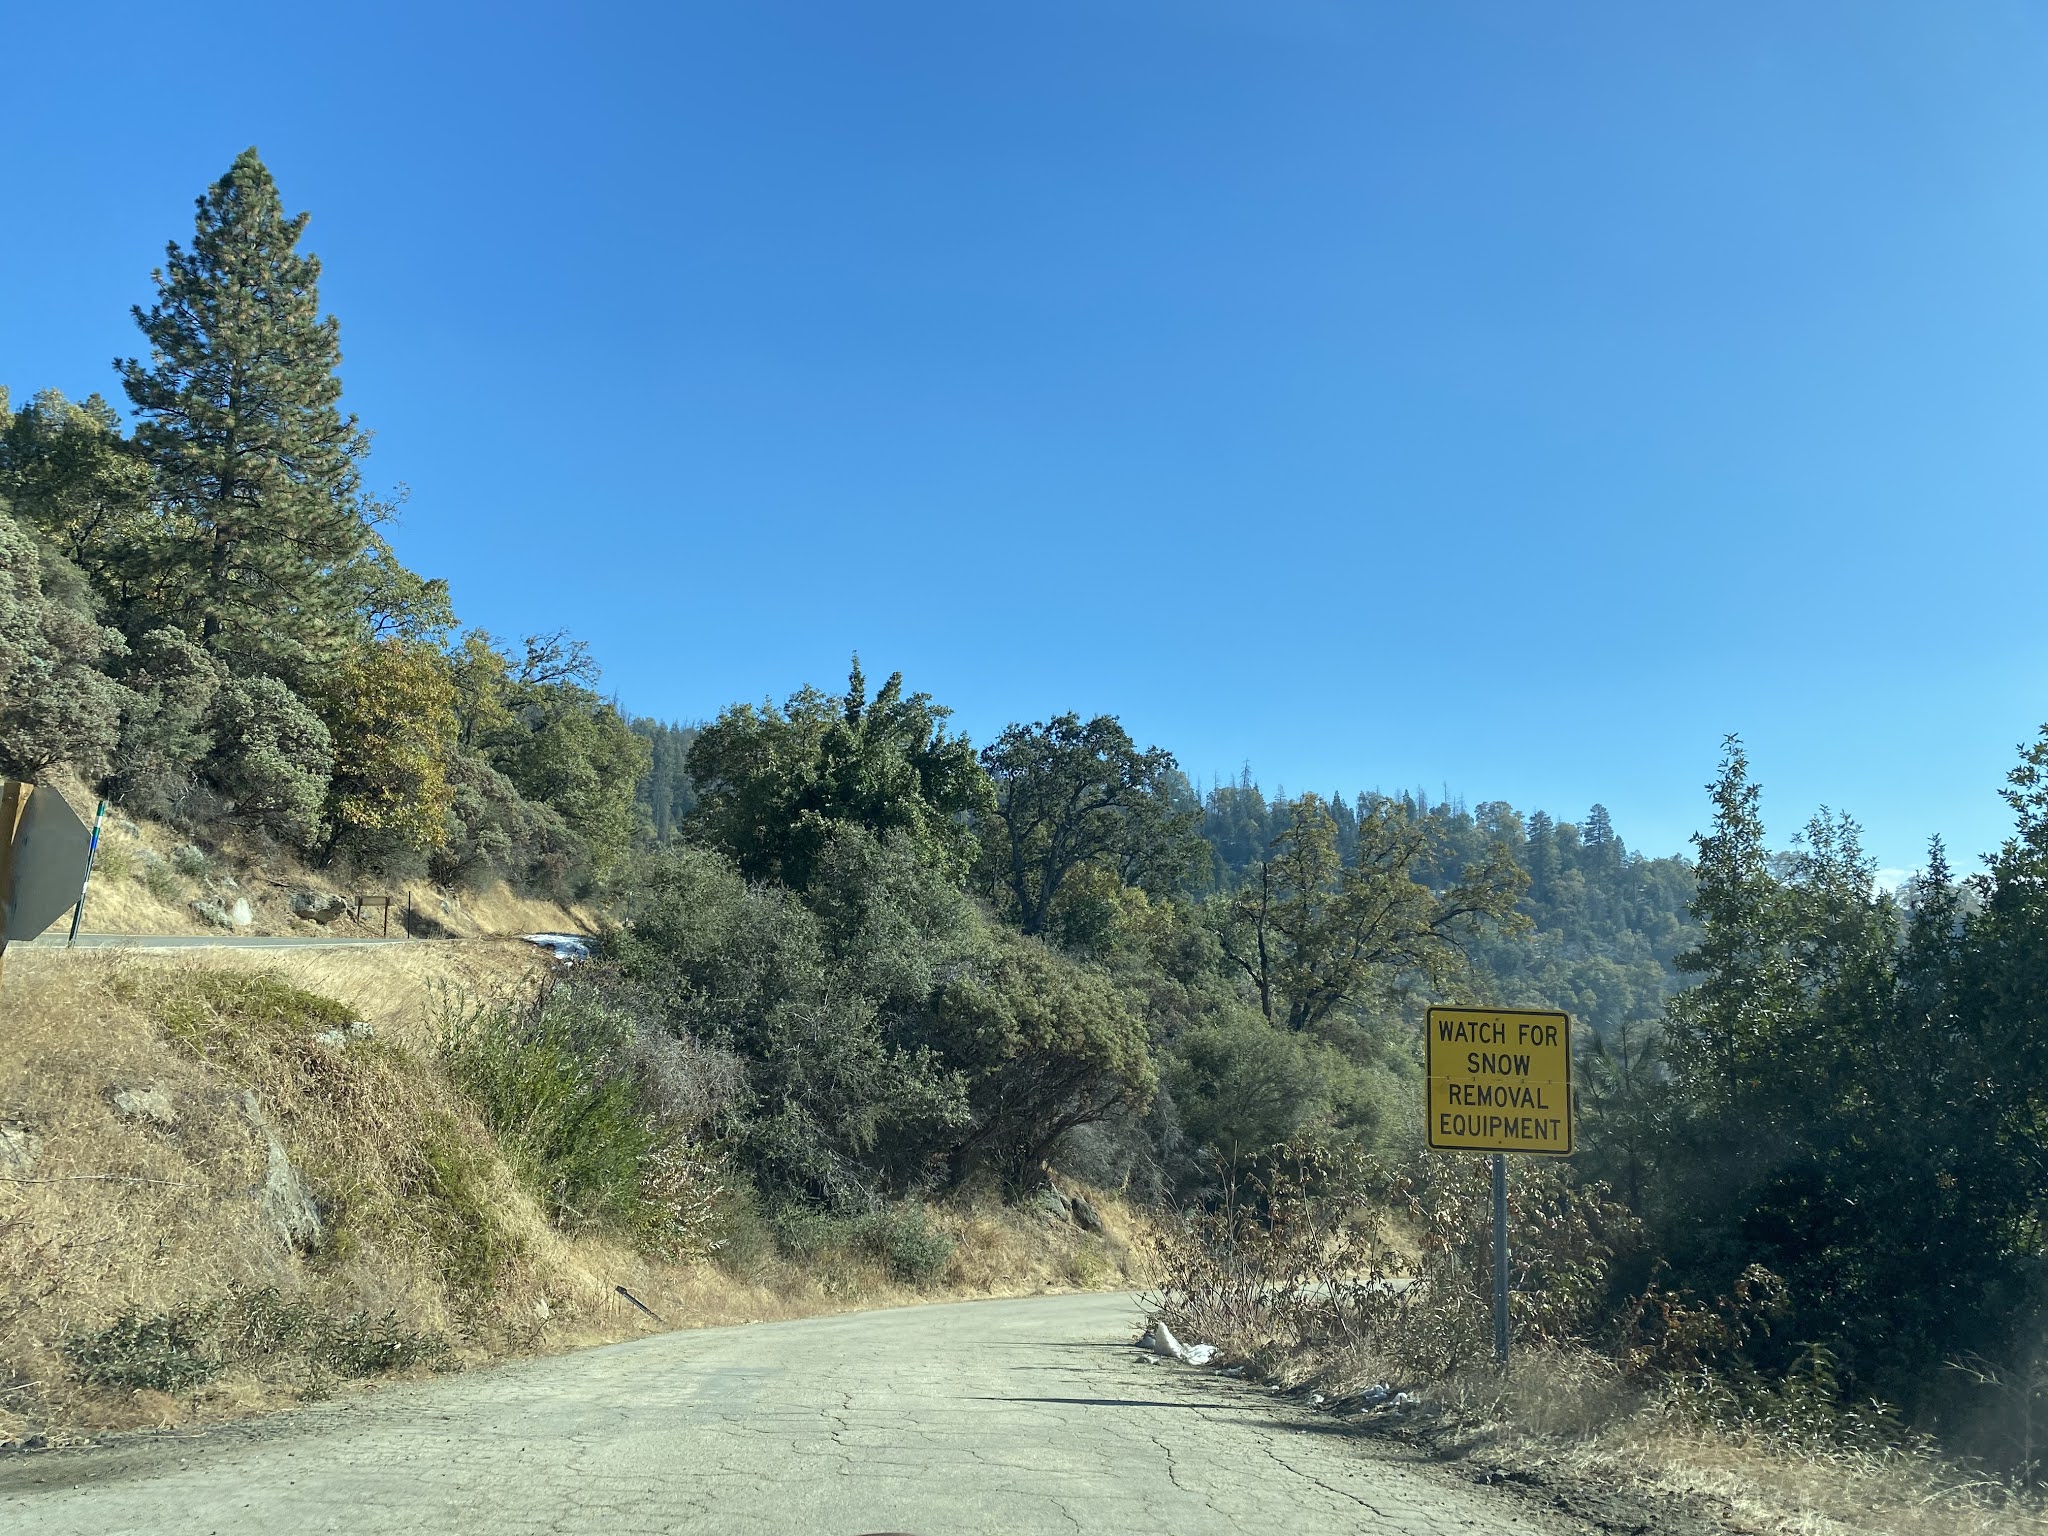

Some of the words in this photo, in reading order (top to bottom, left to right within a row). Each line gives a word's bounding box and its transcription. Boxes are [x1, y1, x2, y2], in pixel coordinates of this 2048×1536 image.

[1439, 1020, 1505, 1044] WATCH
[1518, 1024, 1557, 1046] FOR
[1467, 1052, 1530, 1076] SNOW
[1449, 1084, 1548, 1109] REMOVAL
[1440, 1113, 1560, 1140] EQUIPMENT
